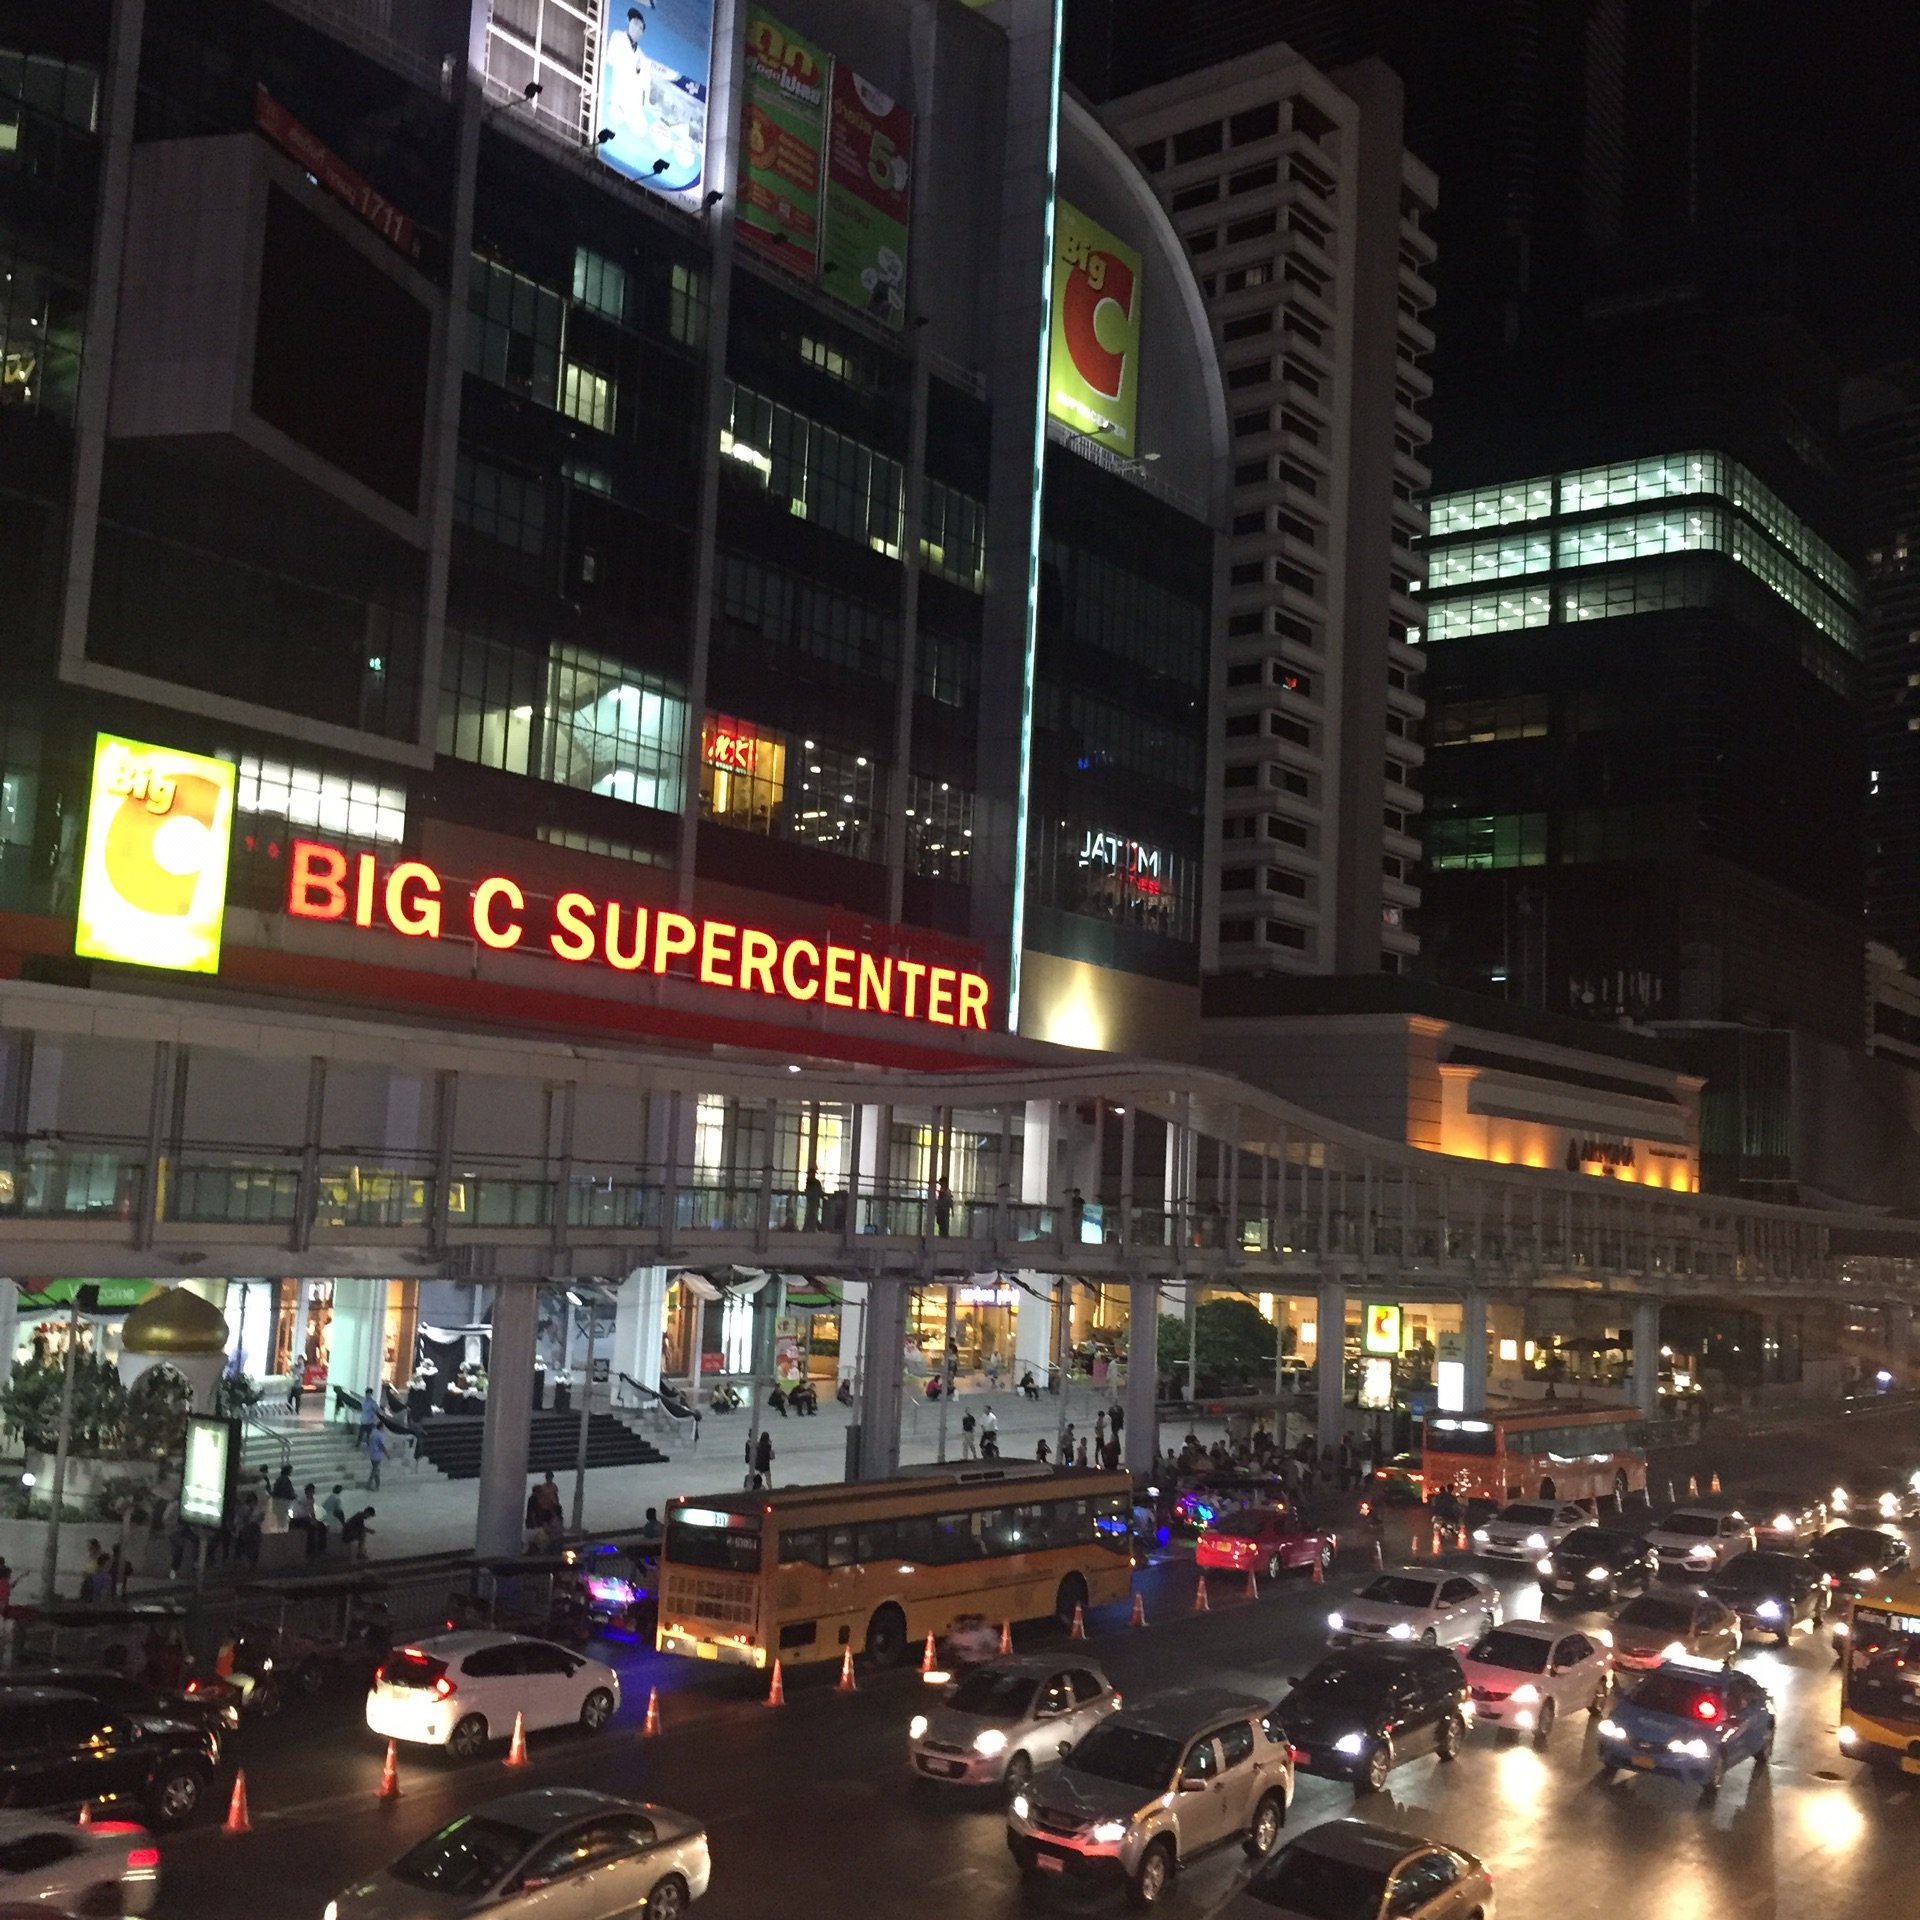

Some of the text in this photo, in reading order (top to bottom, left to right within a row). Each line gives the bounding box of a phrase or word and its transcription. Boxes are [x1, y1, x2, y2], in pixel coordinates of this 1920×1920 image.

[1061, 236, 1107, 292] Big
[1063, 250, 1136, 402] C
[105, 773, 222, 917] C
[107, 761, 178, 815] Big
[289, 838, 441, 939] BIG
[472, 876, 525, 949] C
[551, 892, 989, 1030] SUPERCENTER
